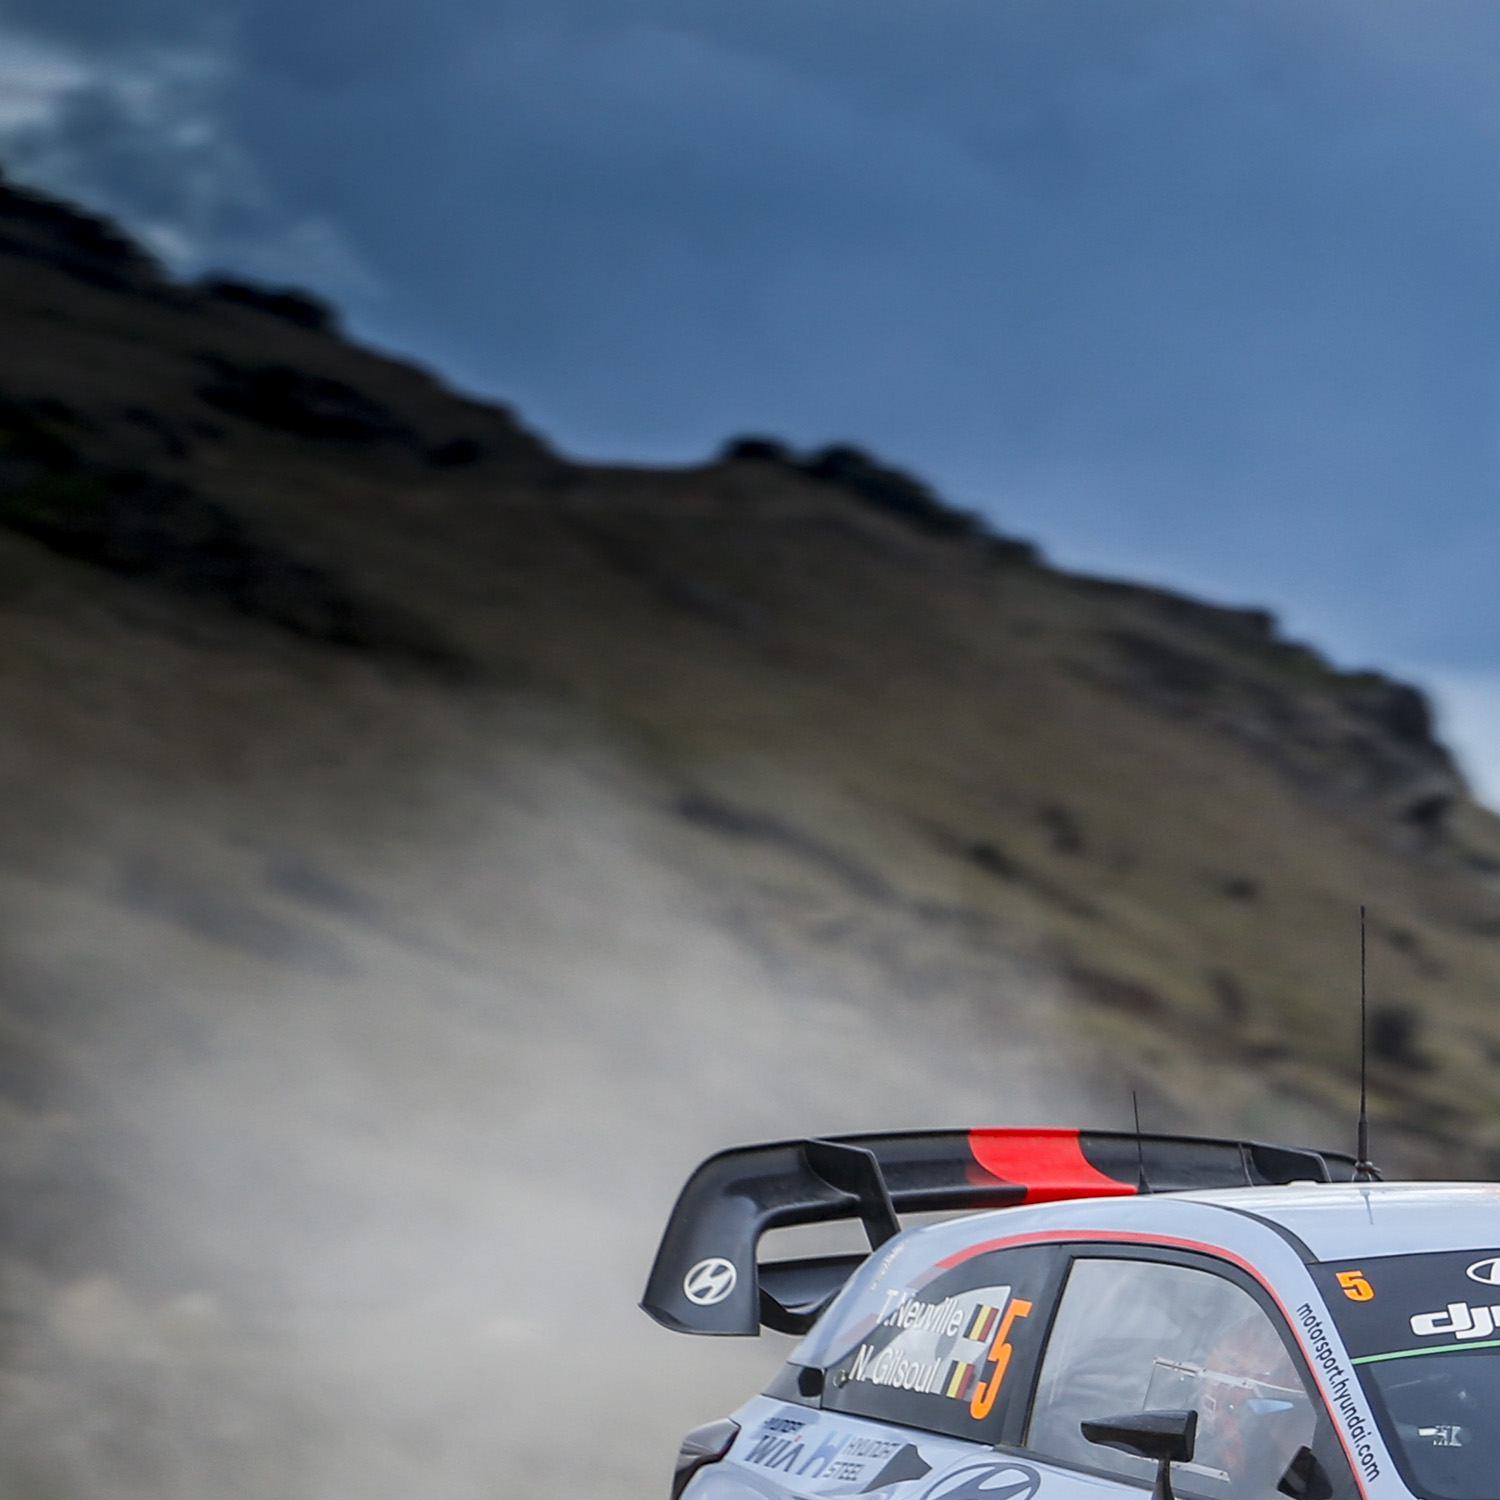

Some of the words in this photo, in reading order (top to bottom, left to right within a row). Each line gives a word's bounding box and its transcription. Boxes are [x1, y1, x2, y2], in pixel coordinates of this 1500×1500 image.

[1335, 1269, 1376, 1302] 5
[969, 1298, 1034, 1421] 5
[1296, 1302, 1382, 1483] motorsport.hyundai.com
